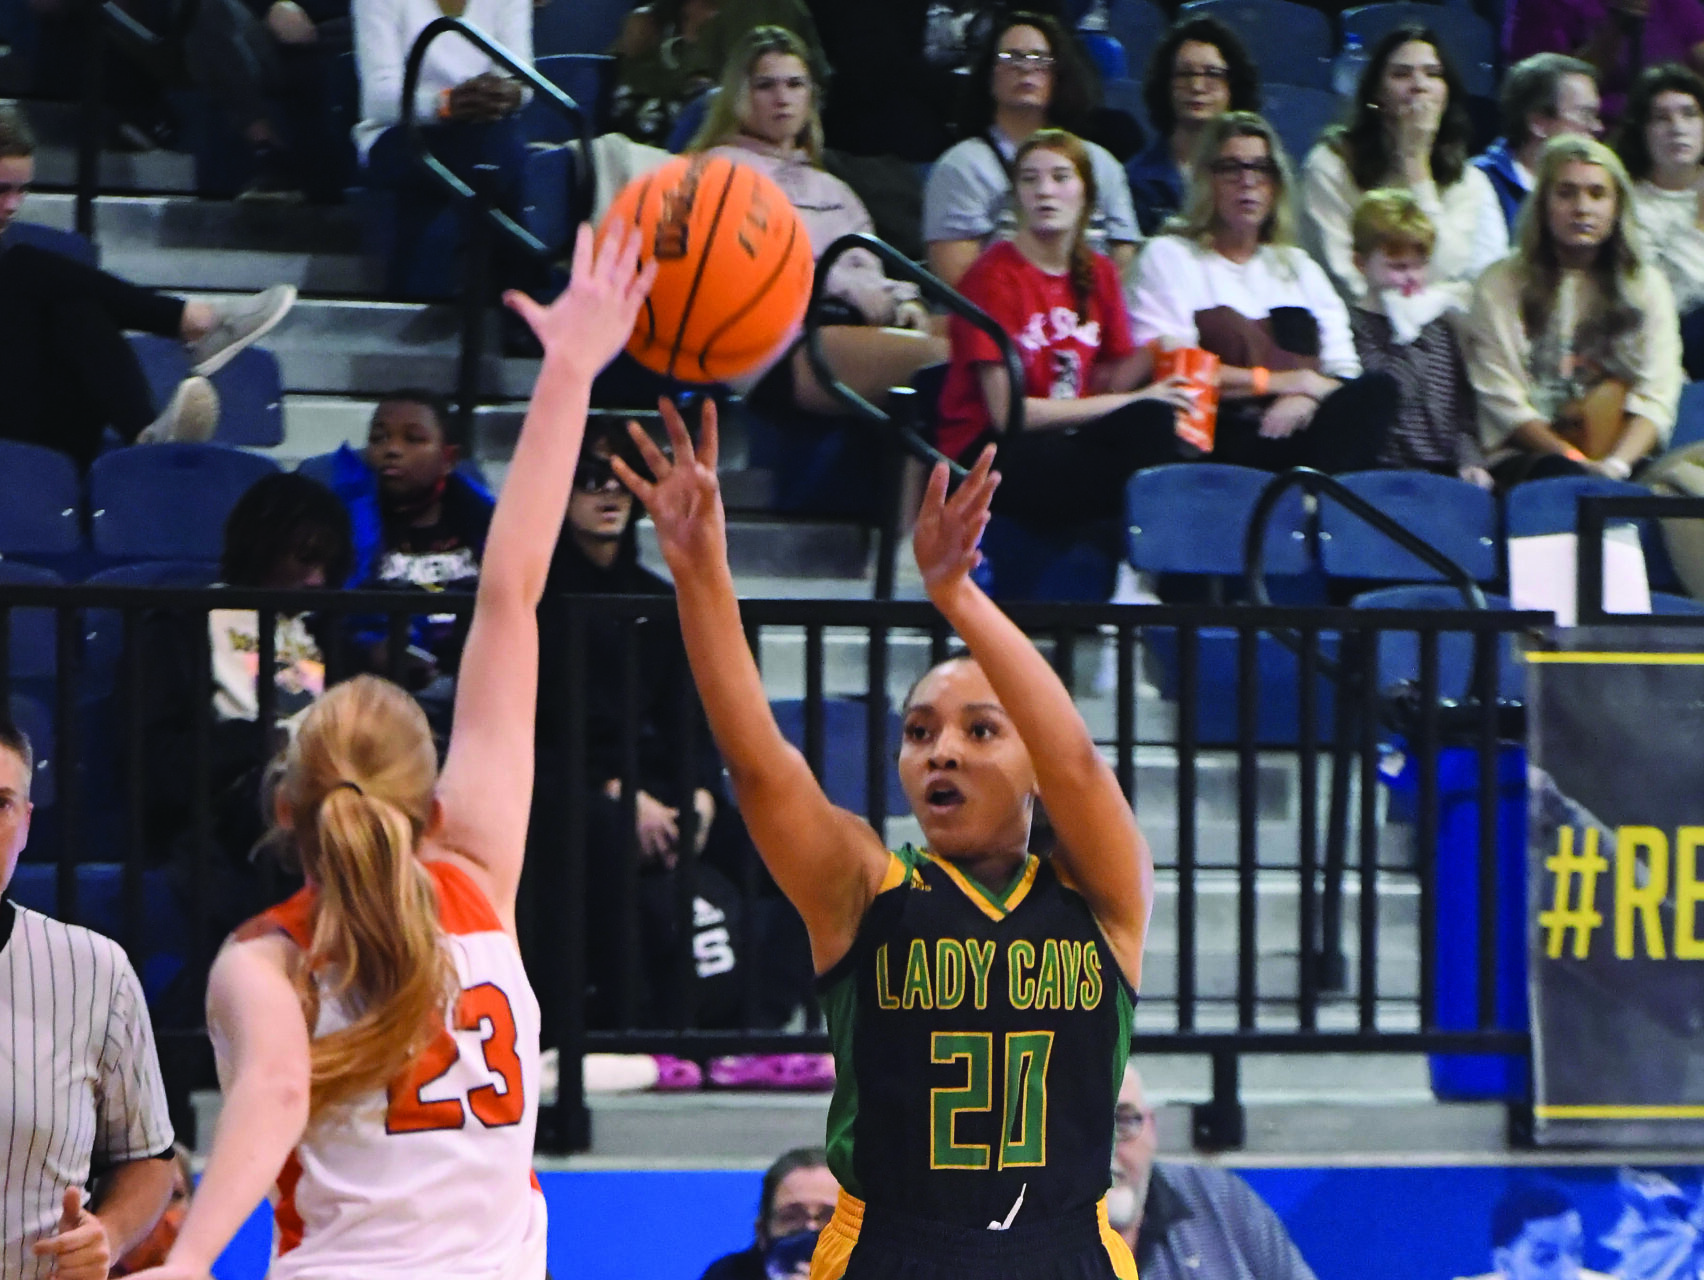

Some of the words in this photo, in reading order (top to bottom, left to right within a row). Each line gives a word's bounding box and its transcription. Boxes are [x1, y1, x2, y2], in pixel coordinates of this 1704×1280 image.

[1538, 825, 1704, 960] #RE
[876, 938, 997, 1010] LADY
[1007, 938, 1103, 1010] CAVS
[385, 981, 525, 1136] 23
[930, 1030, 1055, 1171] 20
